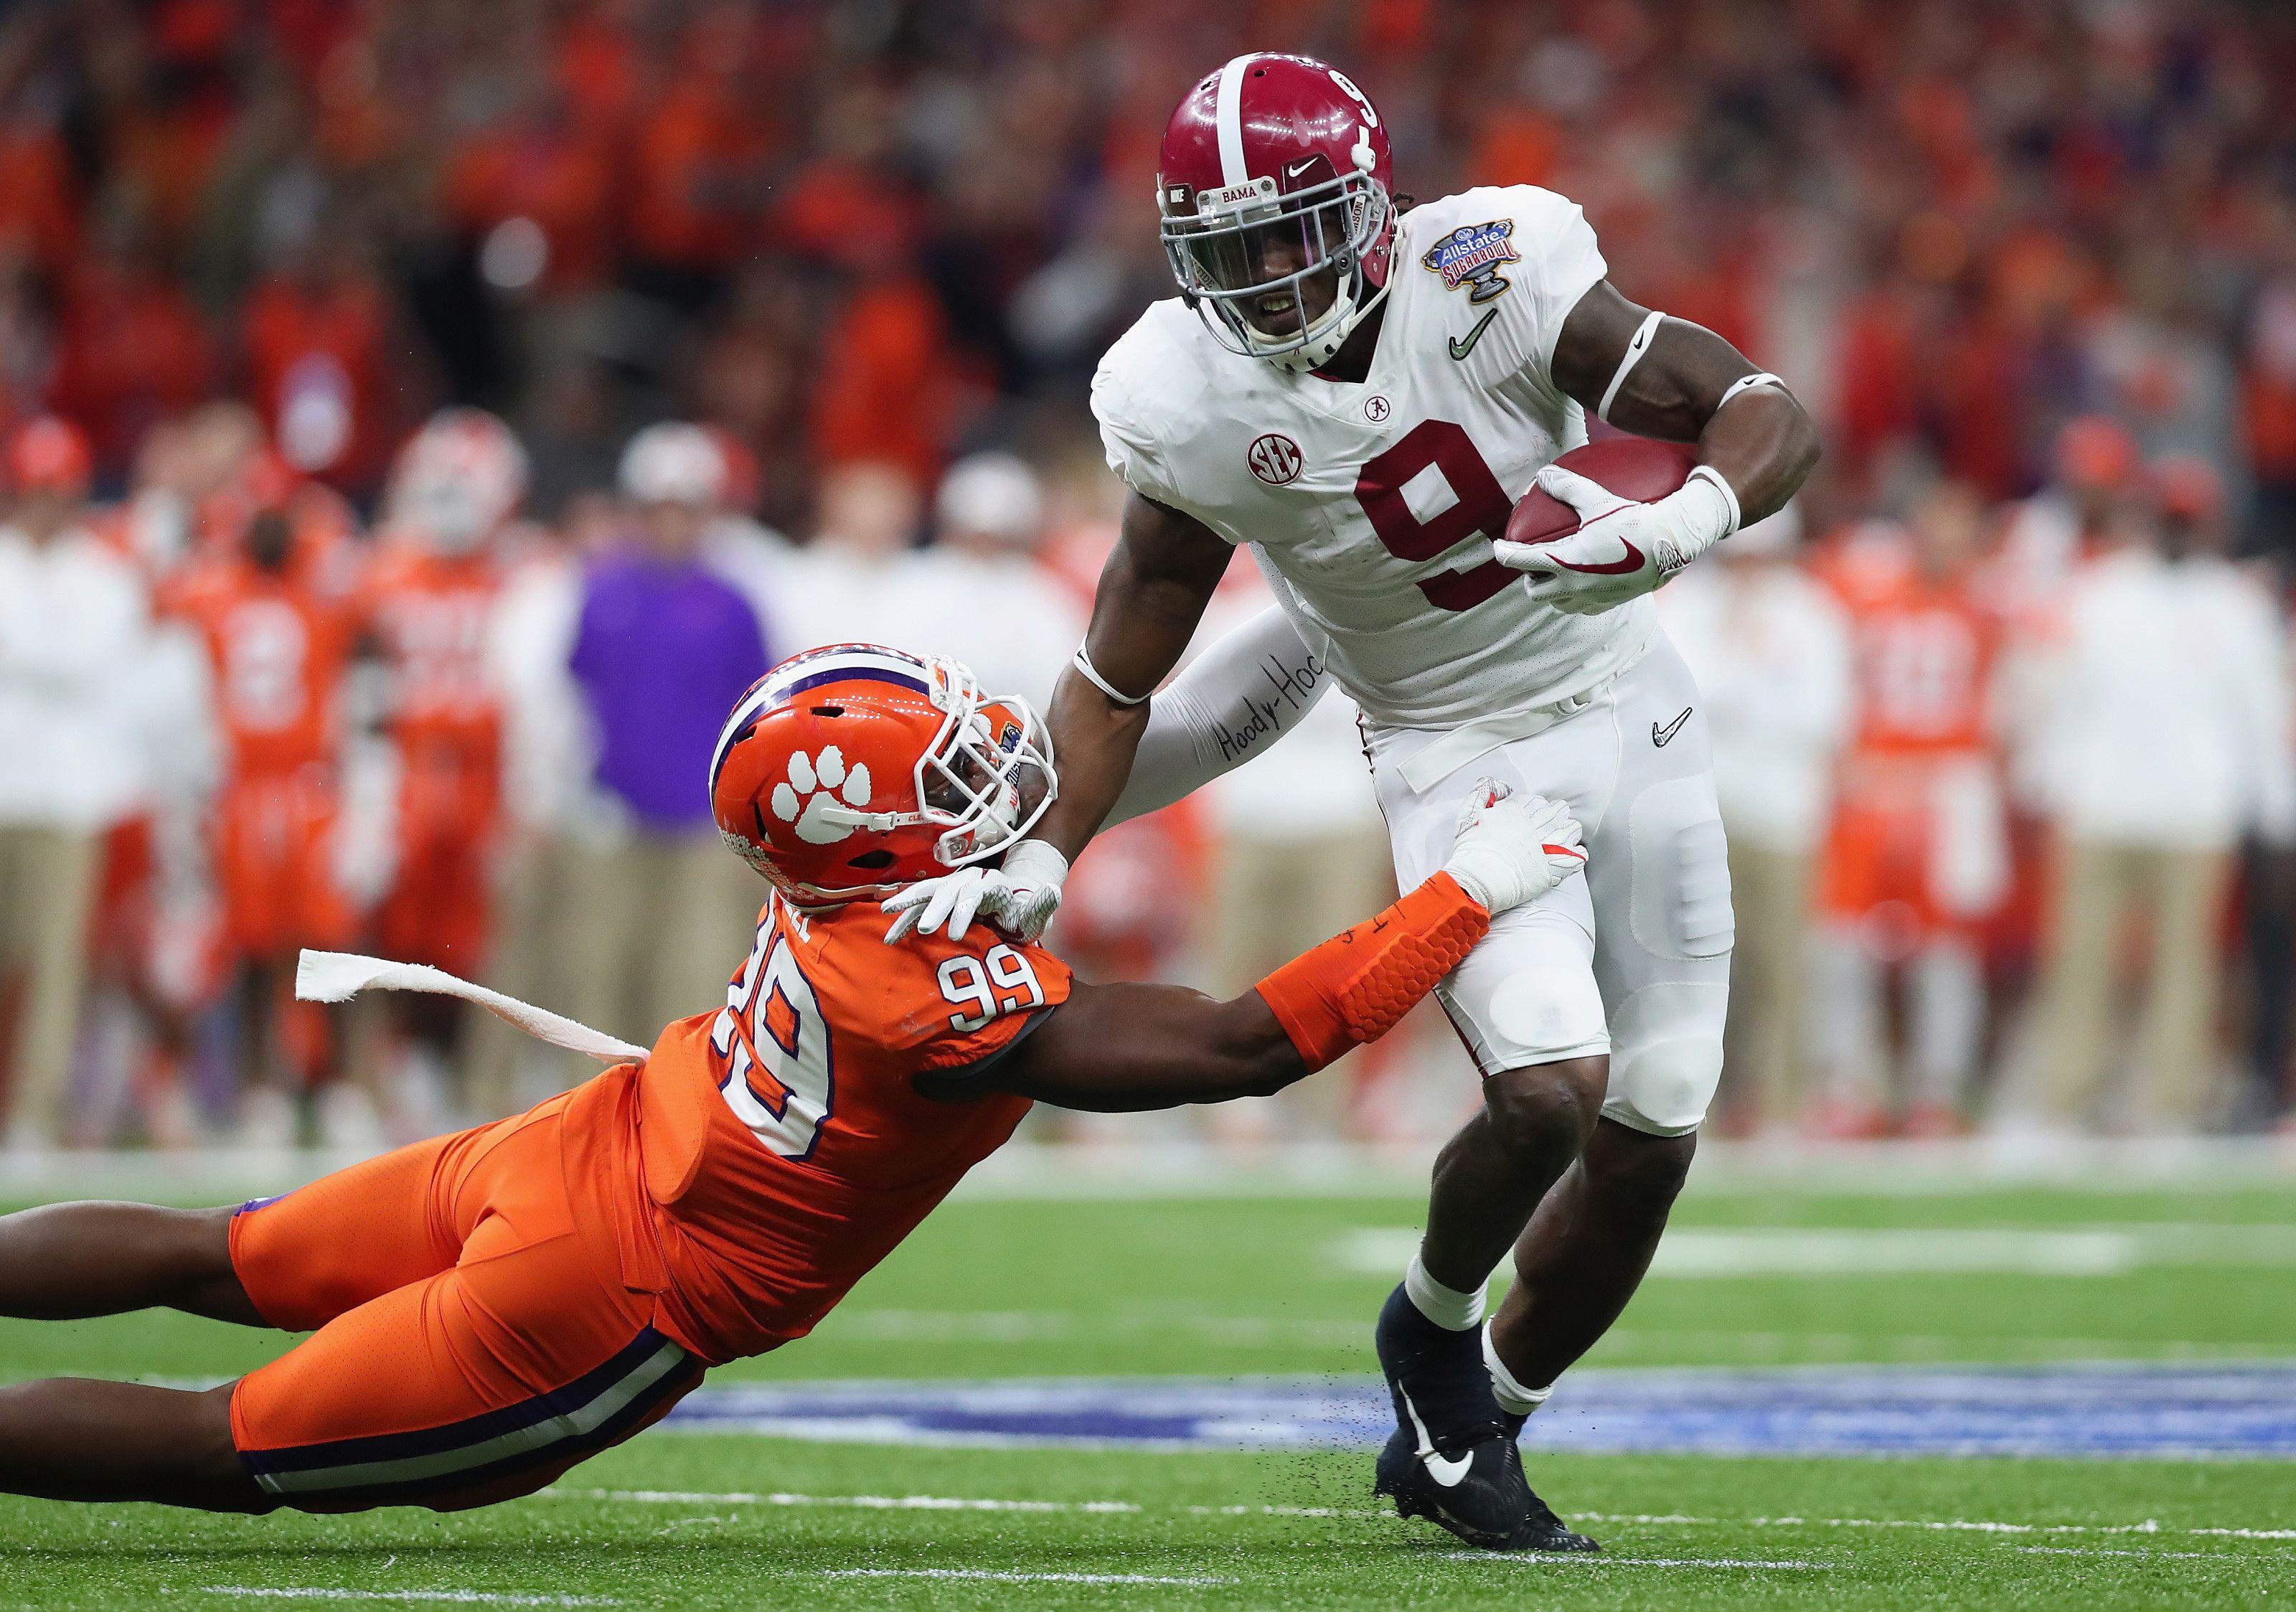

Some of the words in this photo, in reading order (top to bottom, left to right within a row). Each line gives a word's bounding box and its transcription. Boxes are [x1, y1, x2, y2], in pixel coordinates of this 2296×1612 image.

[1327, 70, 1379, 128] 9
[1222, 187, 1257, 203] BAMA
[1251, 437, 1299, 483] SEC
[1354, 418, 1525, 611] 9
[936, 943, 1046, 1033] 99
